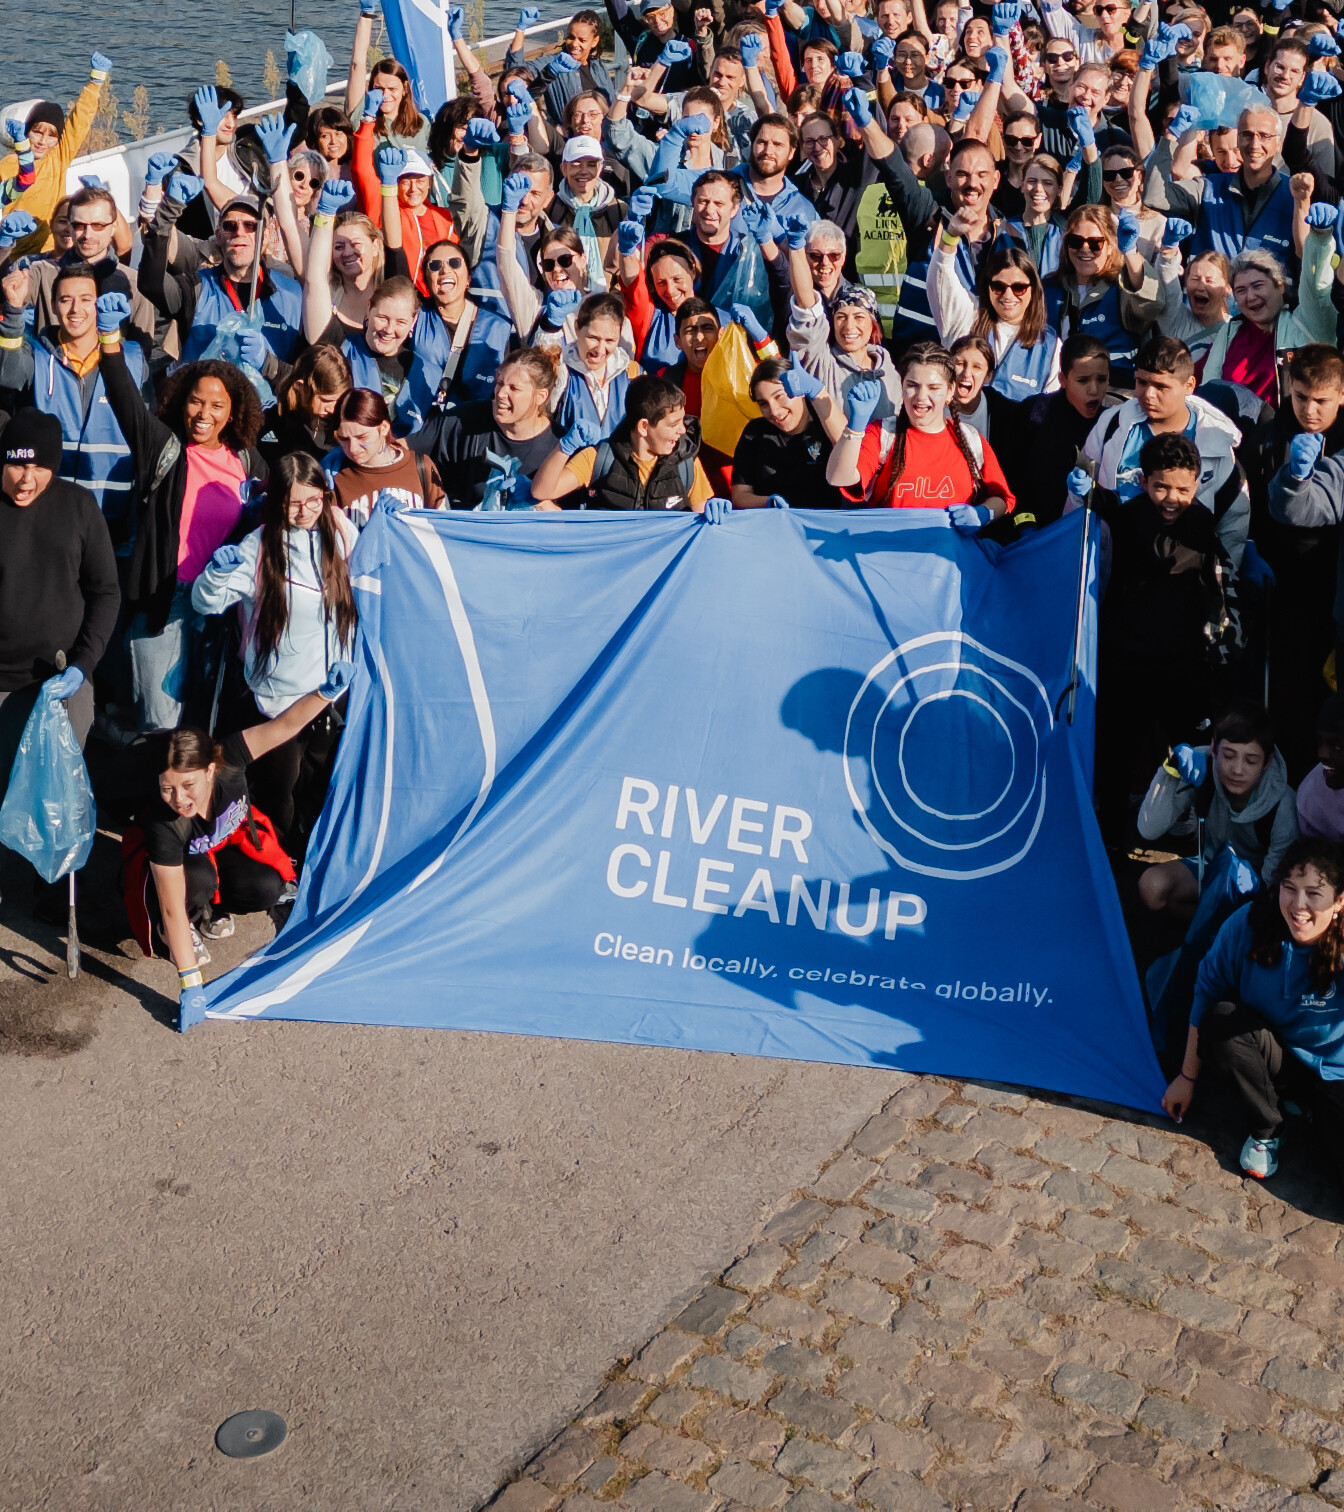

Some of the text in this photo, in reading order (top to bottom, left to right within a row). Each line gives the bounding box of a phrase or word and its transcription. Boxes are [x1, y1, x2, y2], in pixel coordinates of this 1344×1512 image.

[6, 448, 35, 459] PARIS
[897, 476, 955, 498] FILA
[615, 776, 813, 864] RIVER
[606, 844, 928, 941] CLEANUP
[593, 932, 673, 966] Clean
[788, 967, 927, 991] celebrate
[934, 979, 1054, 1008] globally.
